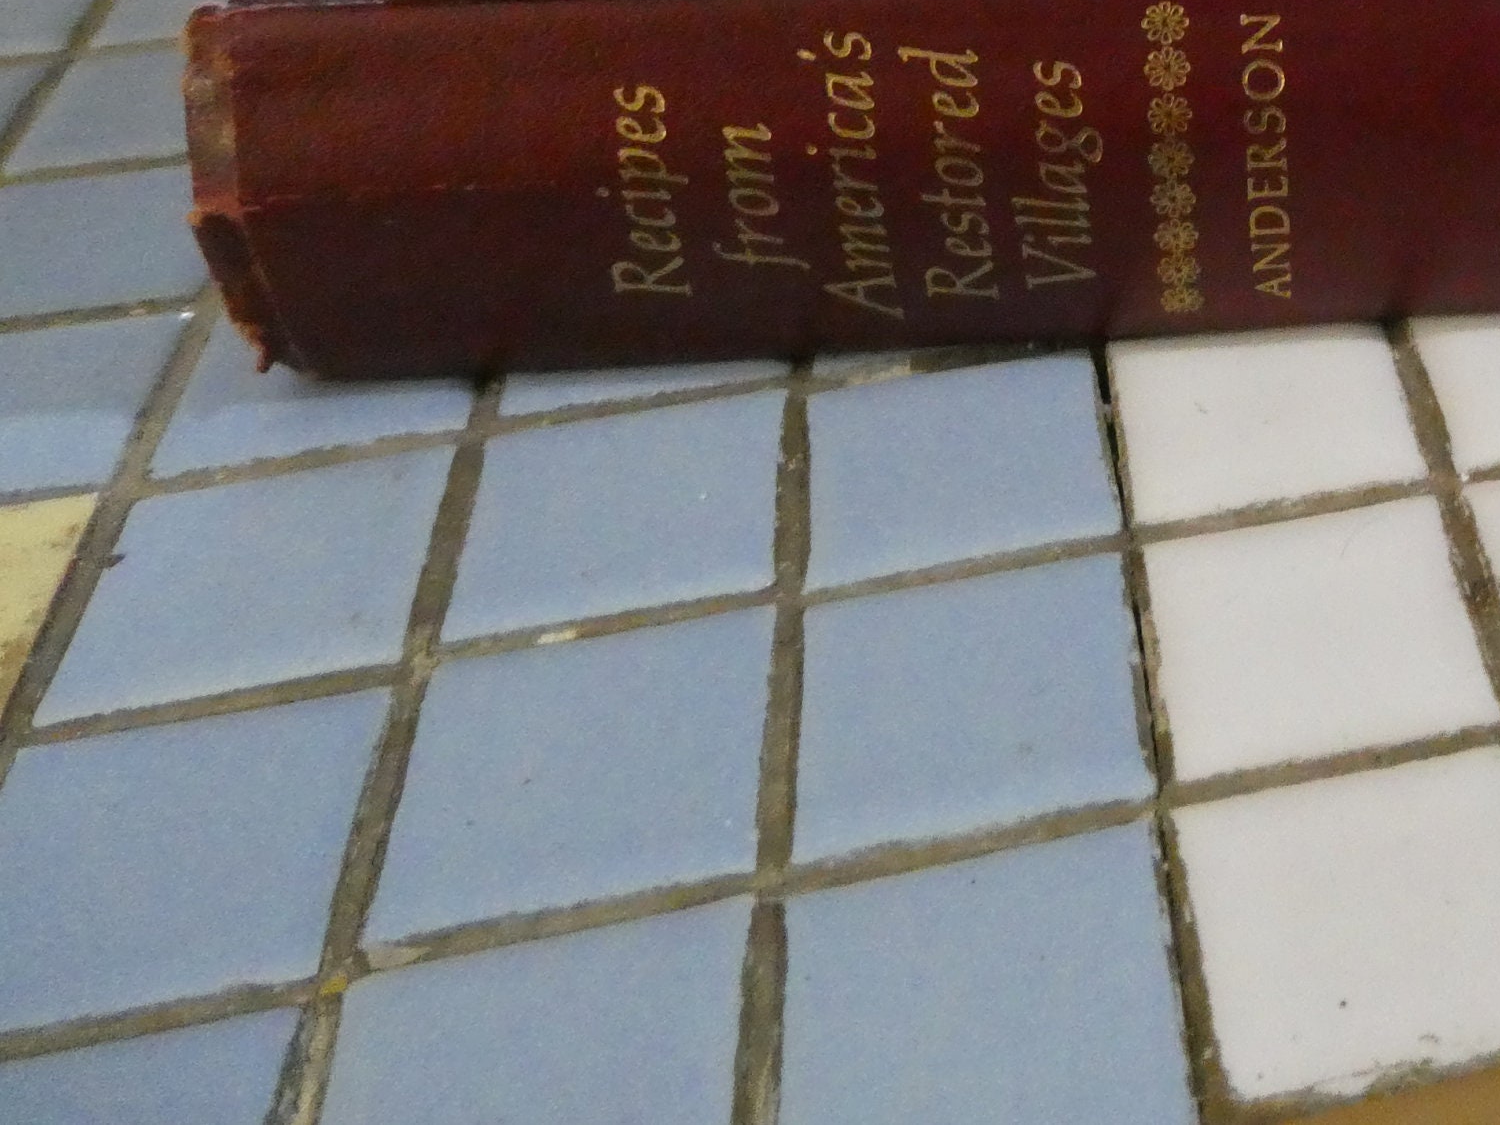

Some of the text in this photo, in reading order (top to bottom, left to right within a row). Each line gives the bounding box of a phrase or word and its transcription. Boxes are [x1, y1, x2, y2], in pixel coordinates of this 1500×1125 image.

[597, 83, 692, 297] Recipes
[713, 122, 810, 270] from
[797, 29, 905, 320] America's
[898, 45, 1001, 300] Restored
[1011, 59, 1103, 290] Villages
[1240, 13, 1292, 299] ANDERSON
